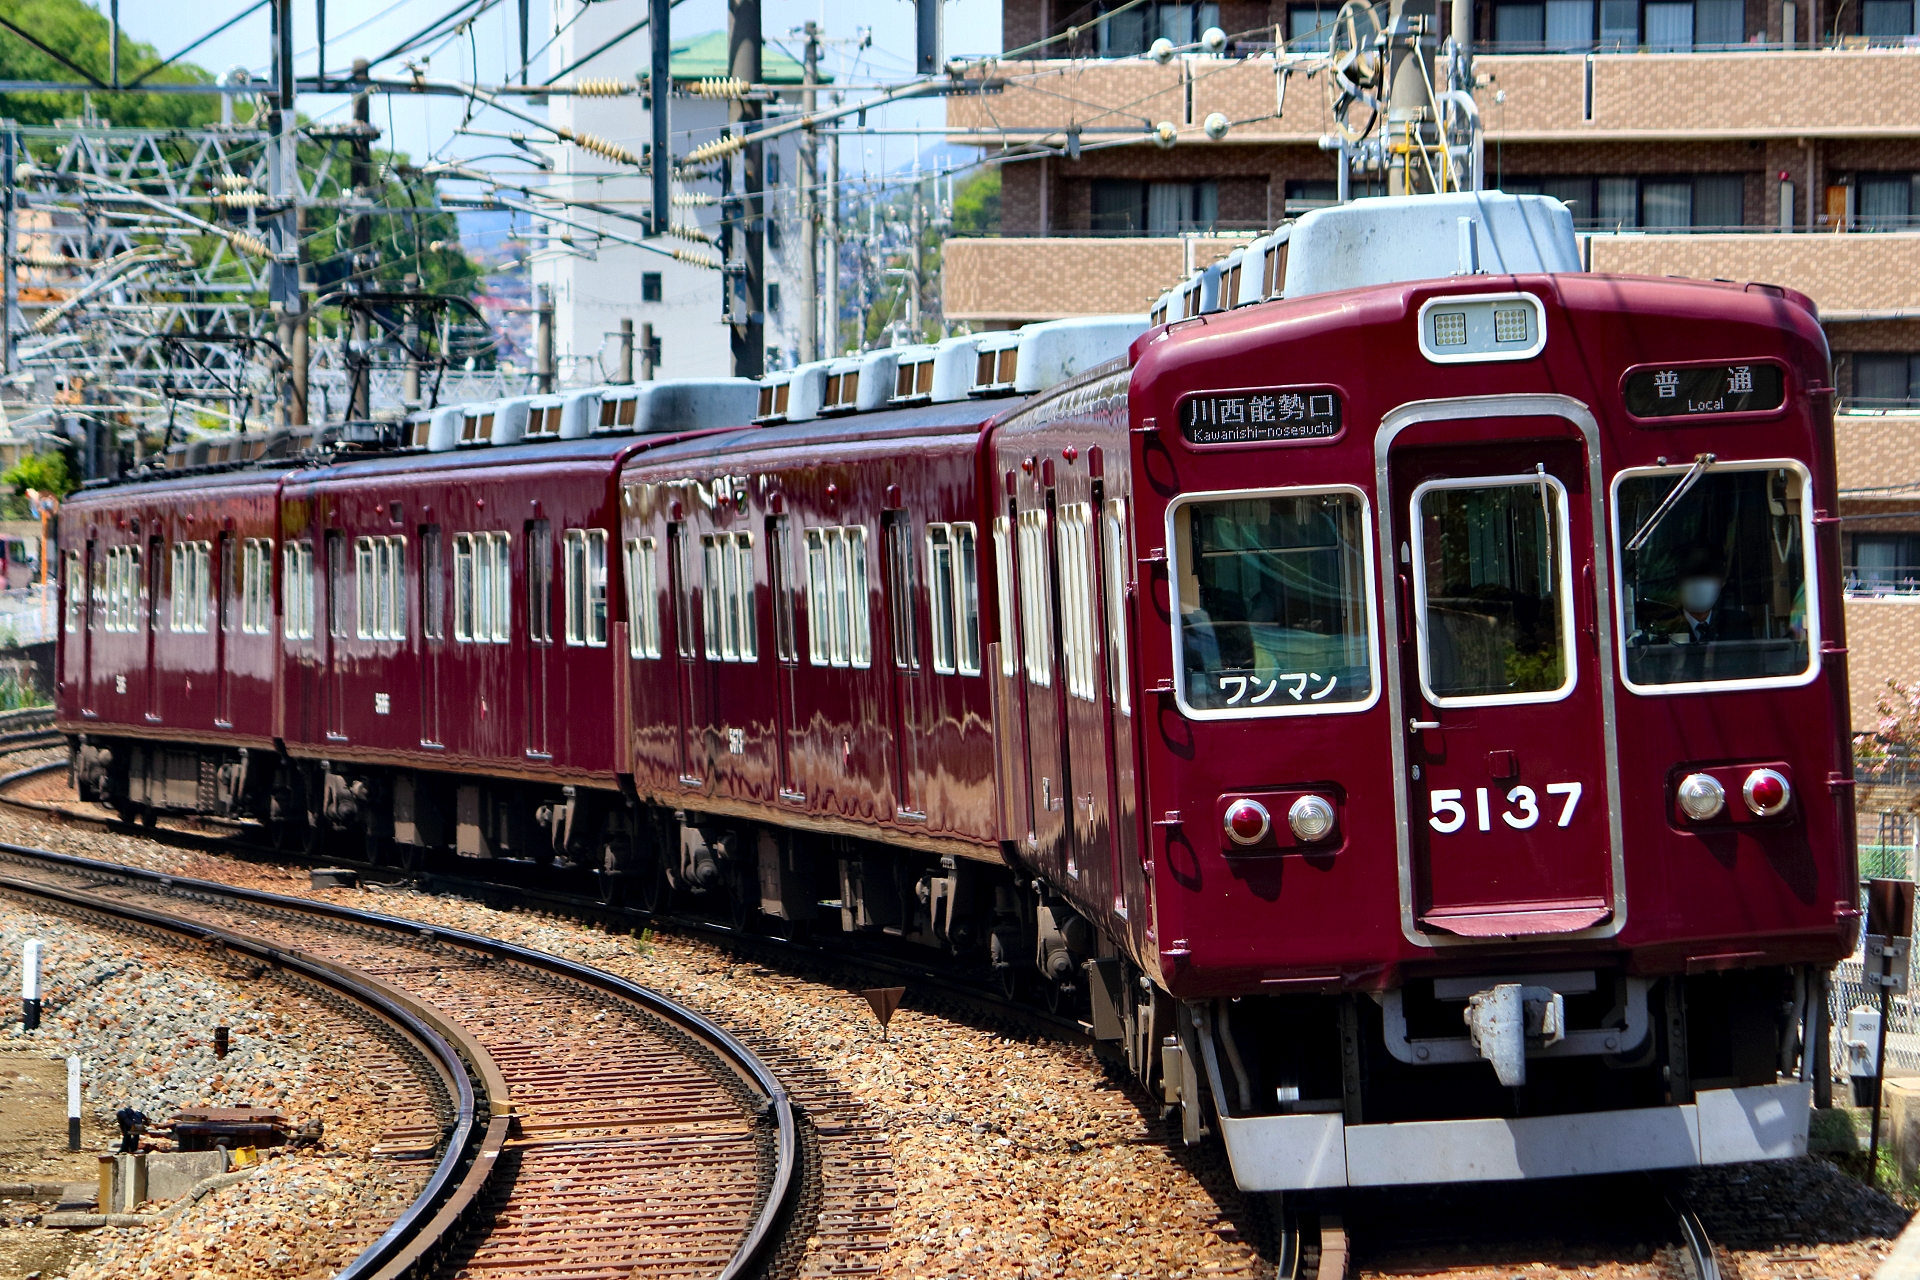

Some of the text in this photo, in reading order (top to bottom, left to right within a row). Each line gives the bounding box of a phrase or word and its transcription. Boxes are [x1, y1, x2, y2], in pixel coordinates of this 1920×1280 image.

[1653, 365, 1754, 399] 普通
[1190, 393, 1334, 426] 川西能勢口
[1688, 397, 1724, 412] Local
[1193, 421, 1334, 442] Kawanishi-noseguchi
[1219, 672, 1338, 705] ワンマン
[1428, 781, 1582, 834] 5137
